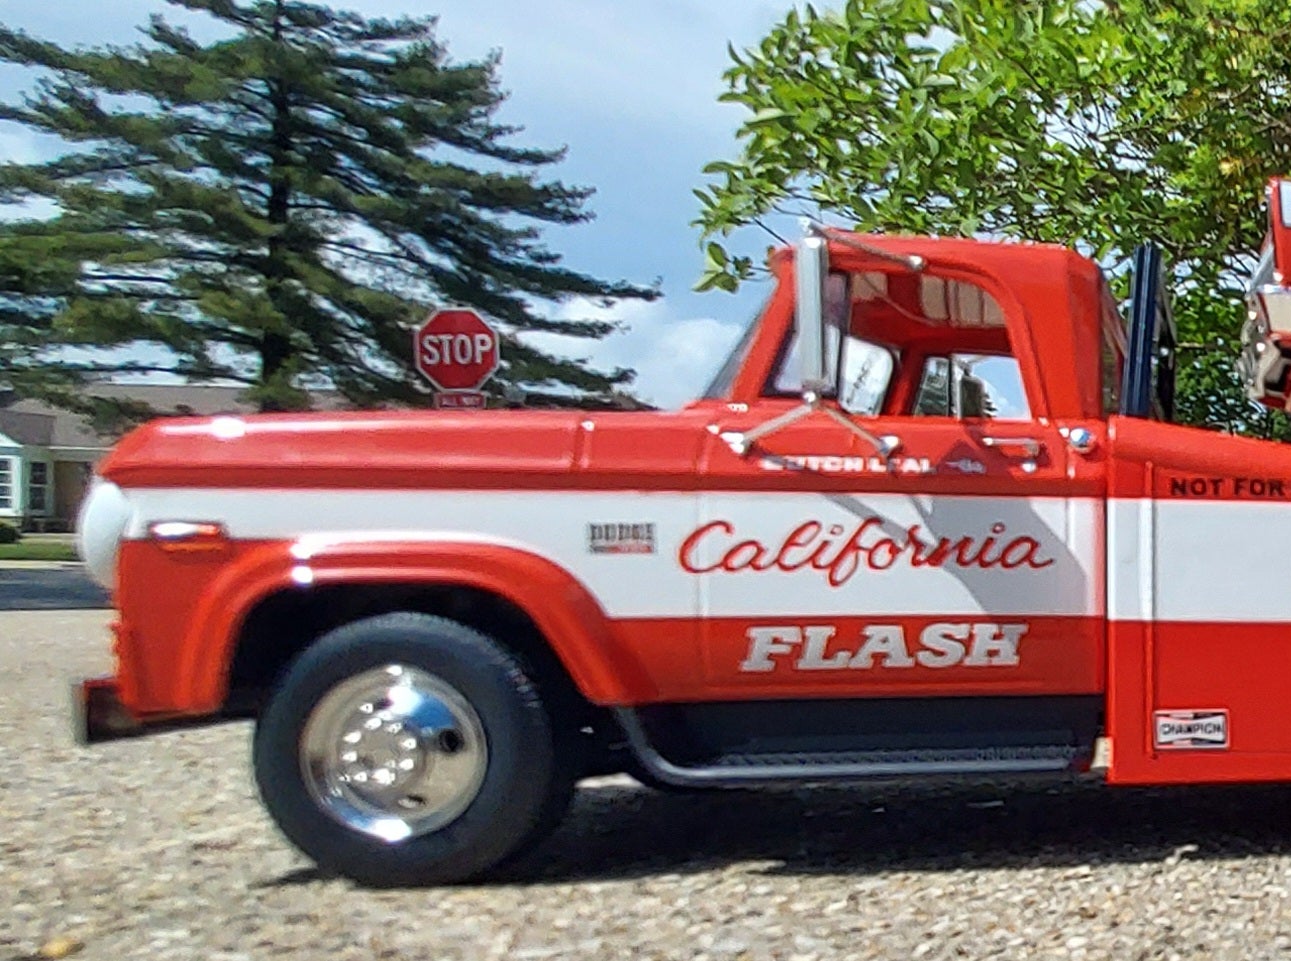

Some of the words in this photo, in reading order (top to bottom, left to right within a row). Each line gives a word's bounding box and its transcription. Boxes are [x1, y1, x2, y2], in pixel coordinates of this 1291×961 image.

[423, 333, 492, 365] STOP
[1170, 477, 1222, 496] NOT
[1233, 477, 1285, 496] FOR
[678, 517, 1056, 587] California
[740, 623, 1028, 672] FLASH
